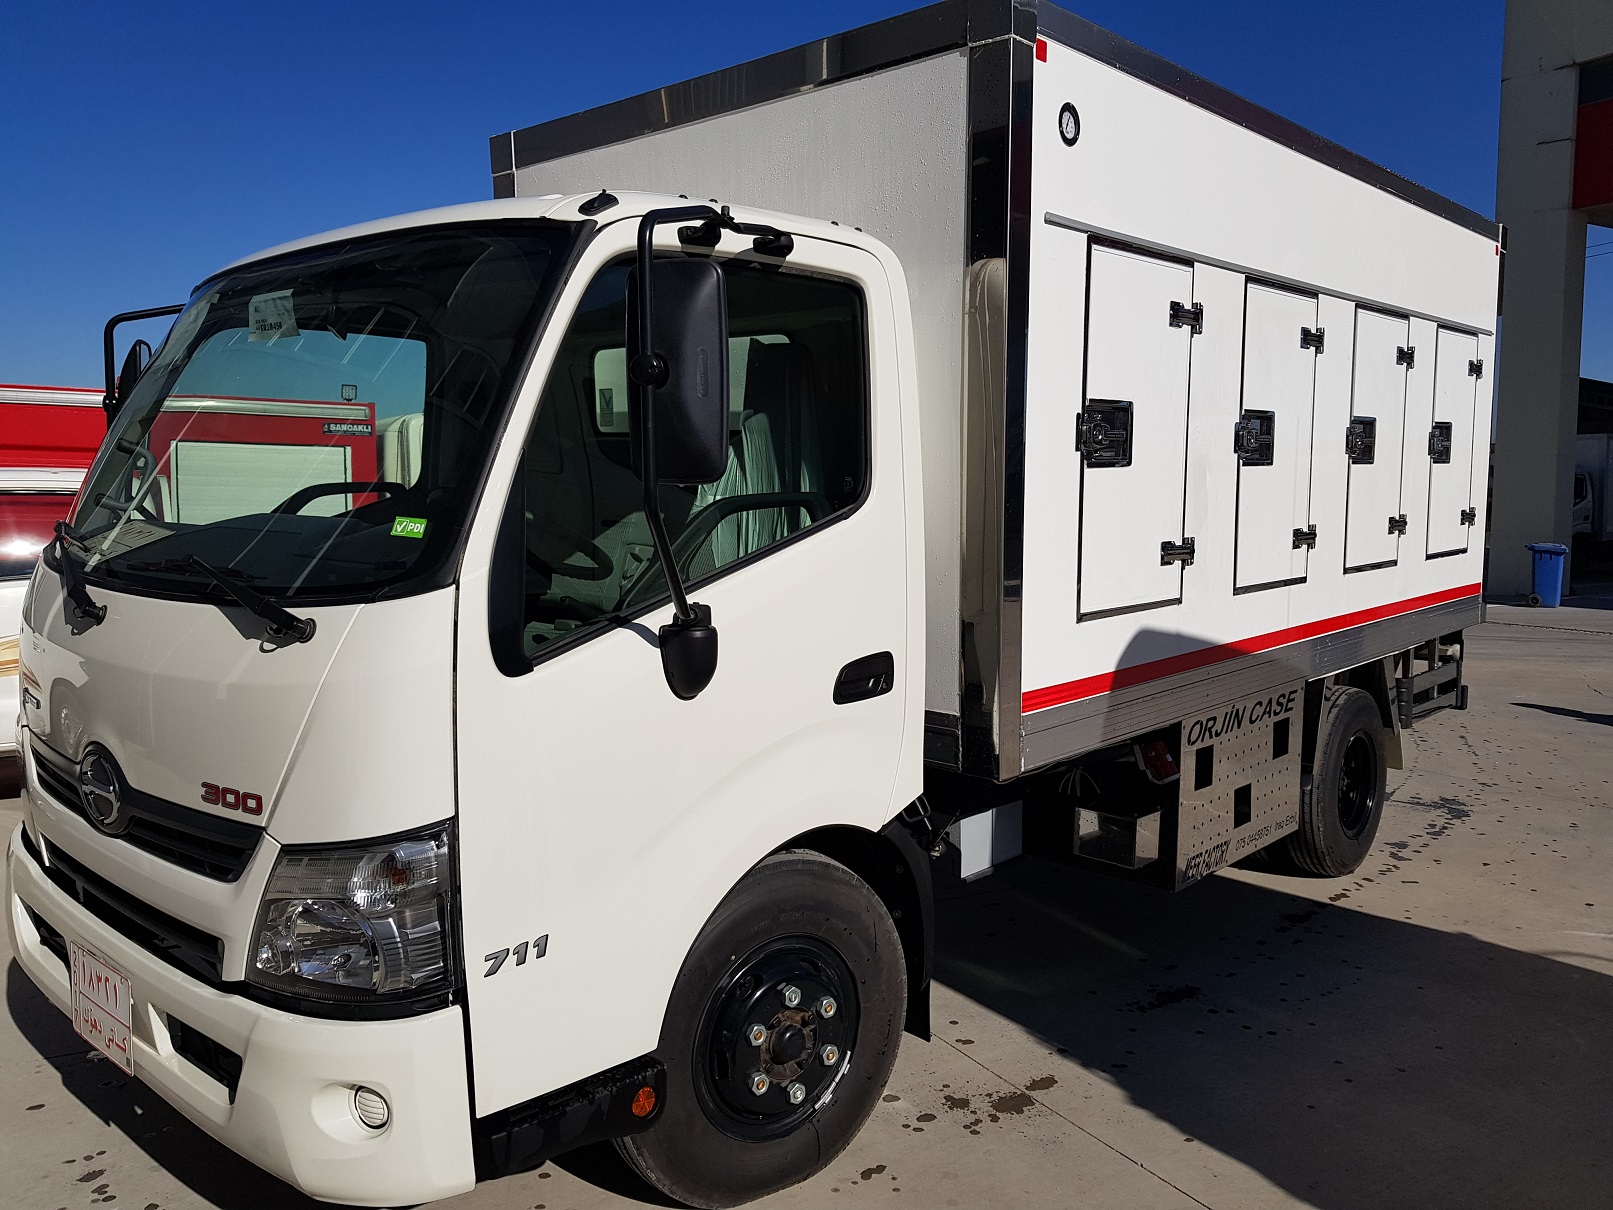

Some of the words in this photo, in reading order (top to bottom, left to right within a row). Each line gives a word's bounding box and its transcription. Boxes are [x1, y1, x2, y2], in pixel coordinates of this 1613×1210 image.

[329, 423, 372, 433] SANCAKLI
[407, 522, 425, 533] PDI
[1248, 688, 1299, 726] CASE
[201, 781, 263, 816] 300
[483, 933, 549, 978] 711
